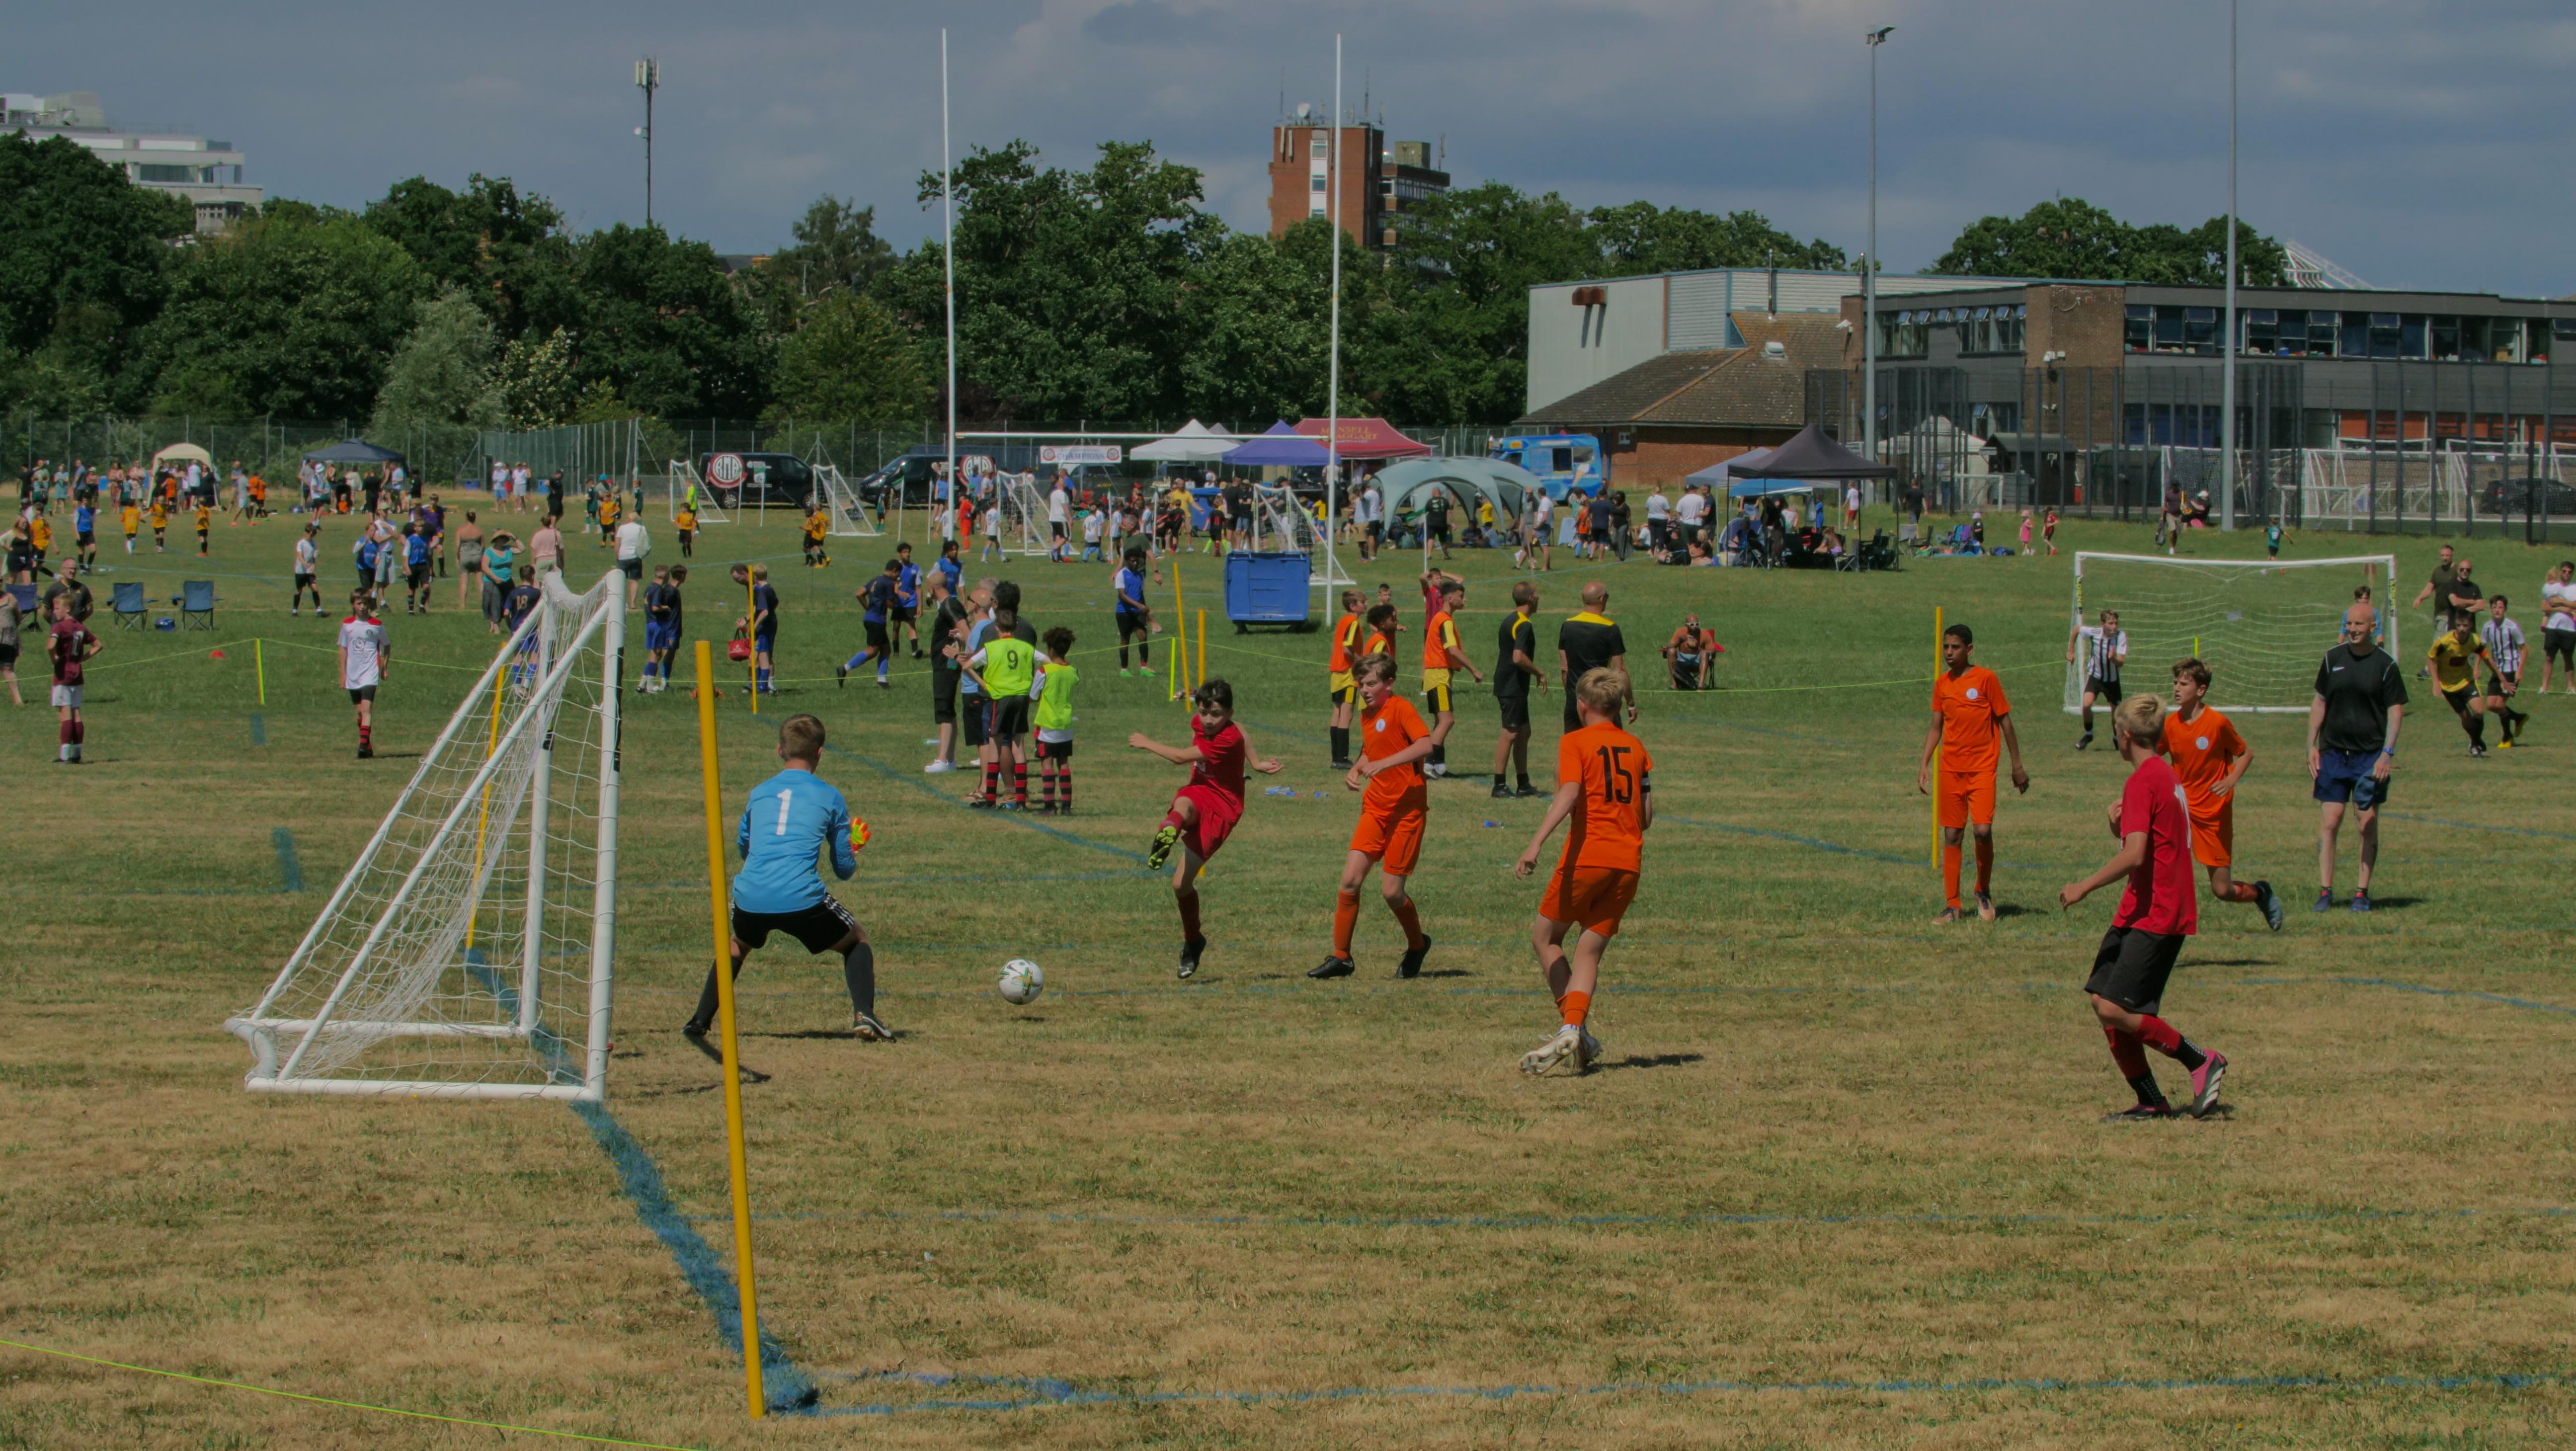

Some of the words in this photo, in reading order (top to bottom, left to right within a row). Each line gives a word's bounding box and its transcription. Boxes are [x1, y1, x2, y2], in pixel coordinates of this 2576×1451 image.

[516, 595, 528, 610] 18
[1007, 649, 1018, 670] 9
[1597, 745, 1633, 805] 15
[776, 789, 792, 836] 1
